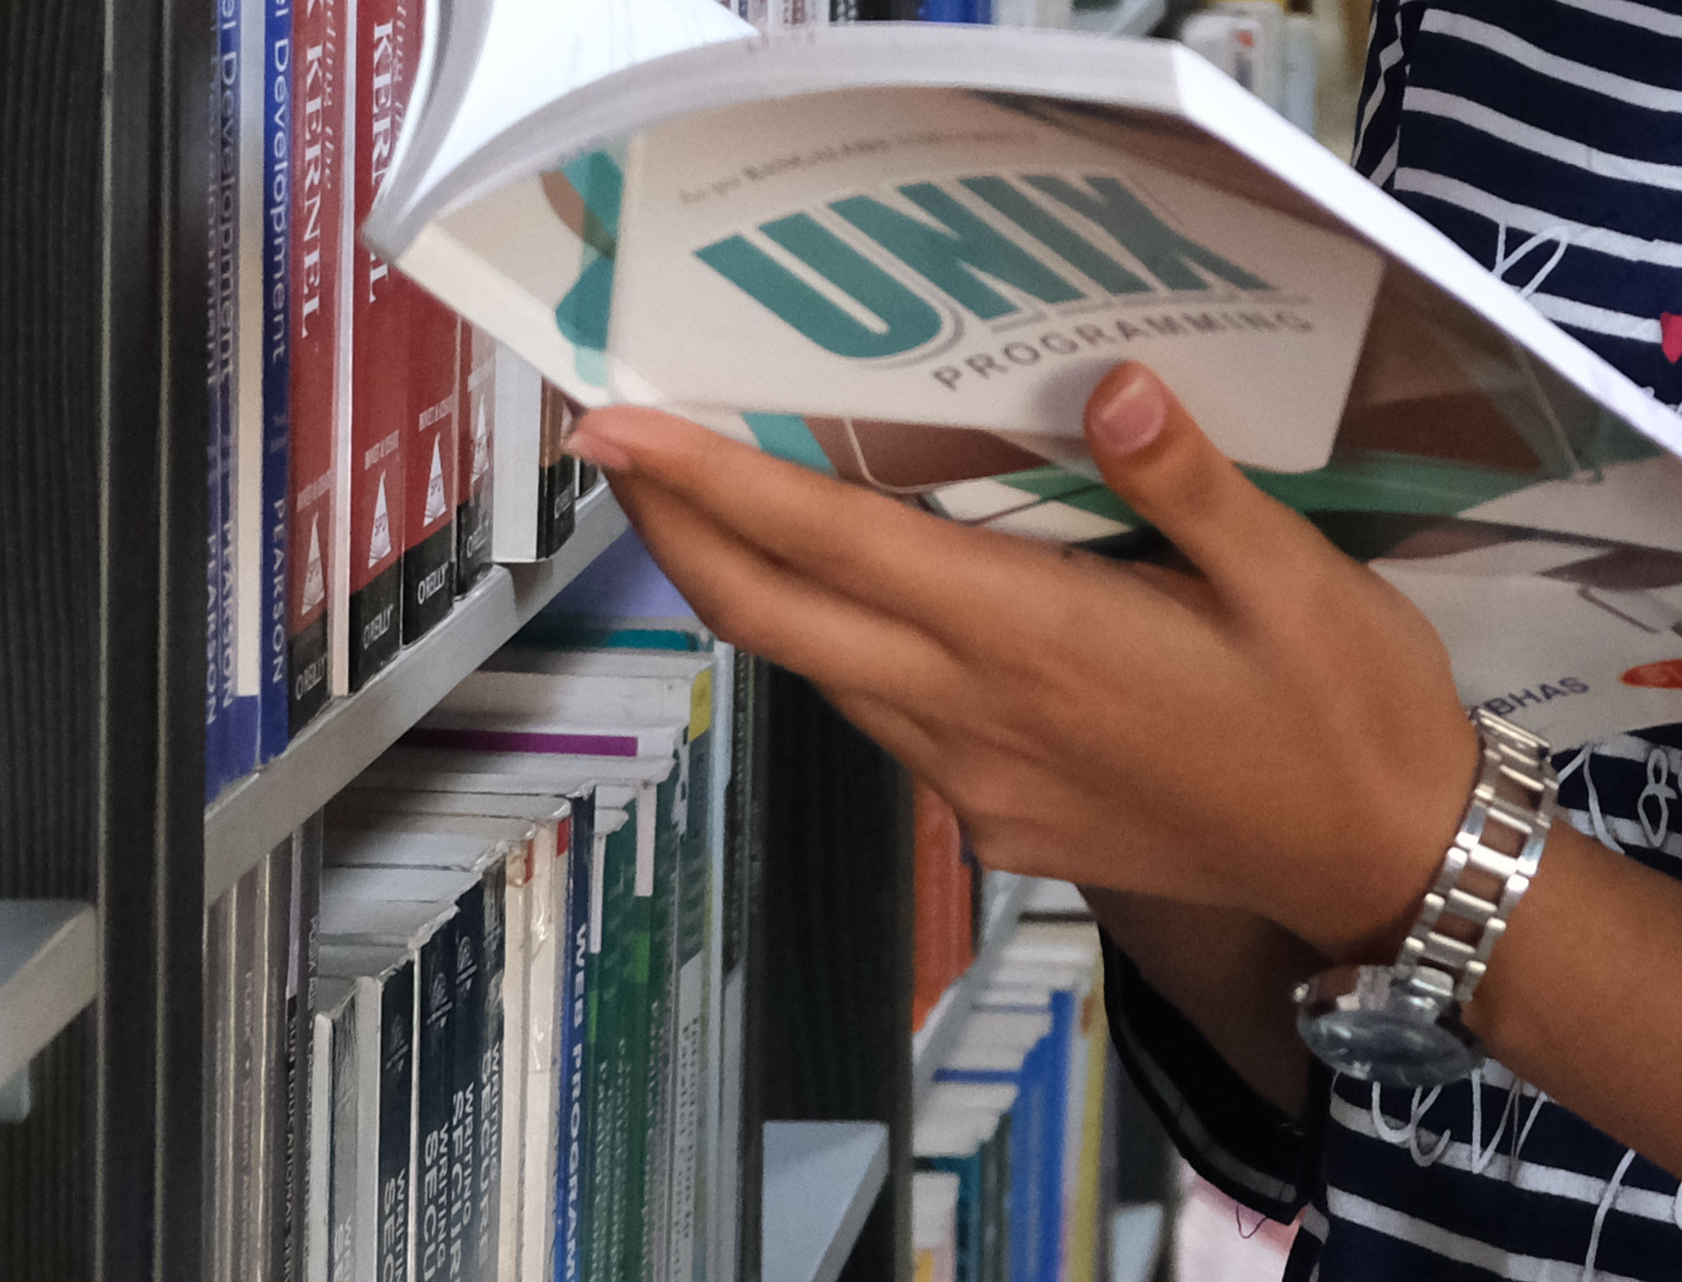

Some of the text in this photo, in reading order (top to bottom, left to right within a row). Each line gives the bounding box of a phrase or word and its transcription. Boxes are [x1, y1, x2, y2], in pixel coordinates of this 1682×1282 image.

[220, 50, 237, 382] Development
[270, 38, 289, 363] Development
[301, 44, 323, 338] KERNEL
[692, 173, 1278, 359] UNIX
[931, 310, 1314, 392] PROGRAMMING
[207, 534, 217, 724] PEARSON
[223, 520, 232, 708] PEARSON
[272, 497, 284, 683] PEARSON
[574, 923, 587, 1029] WEB
[436, 1122, 449, 1268] WRITING
[463, 1082, 474, 1226] WRITING
[479, 1050, 491, 1270] SECURE
[490, 1042, 499, 1181] WRITING
